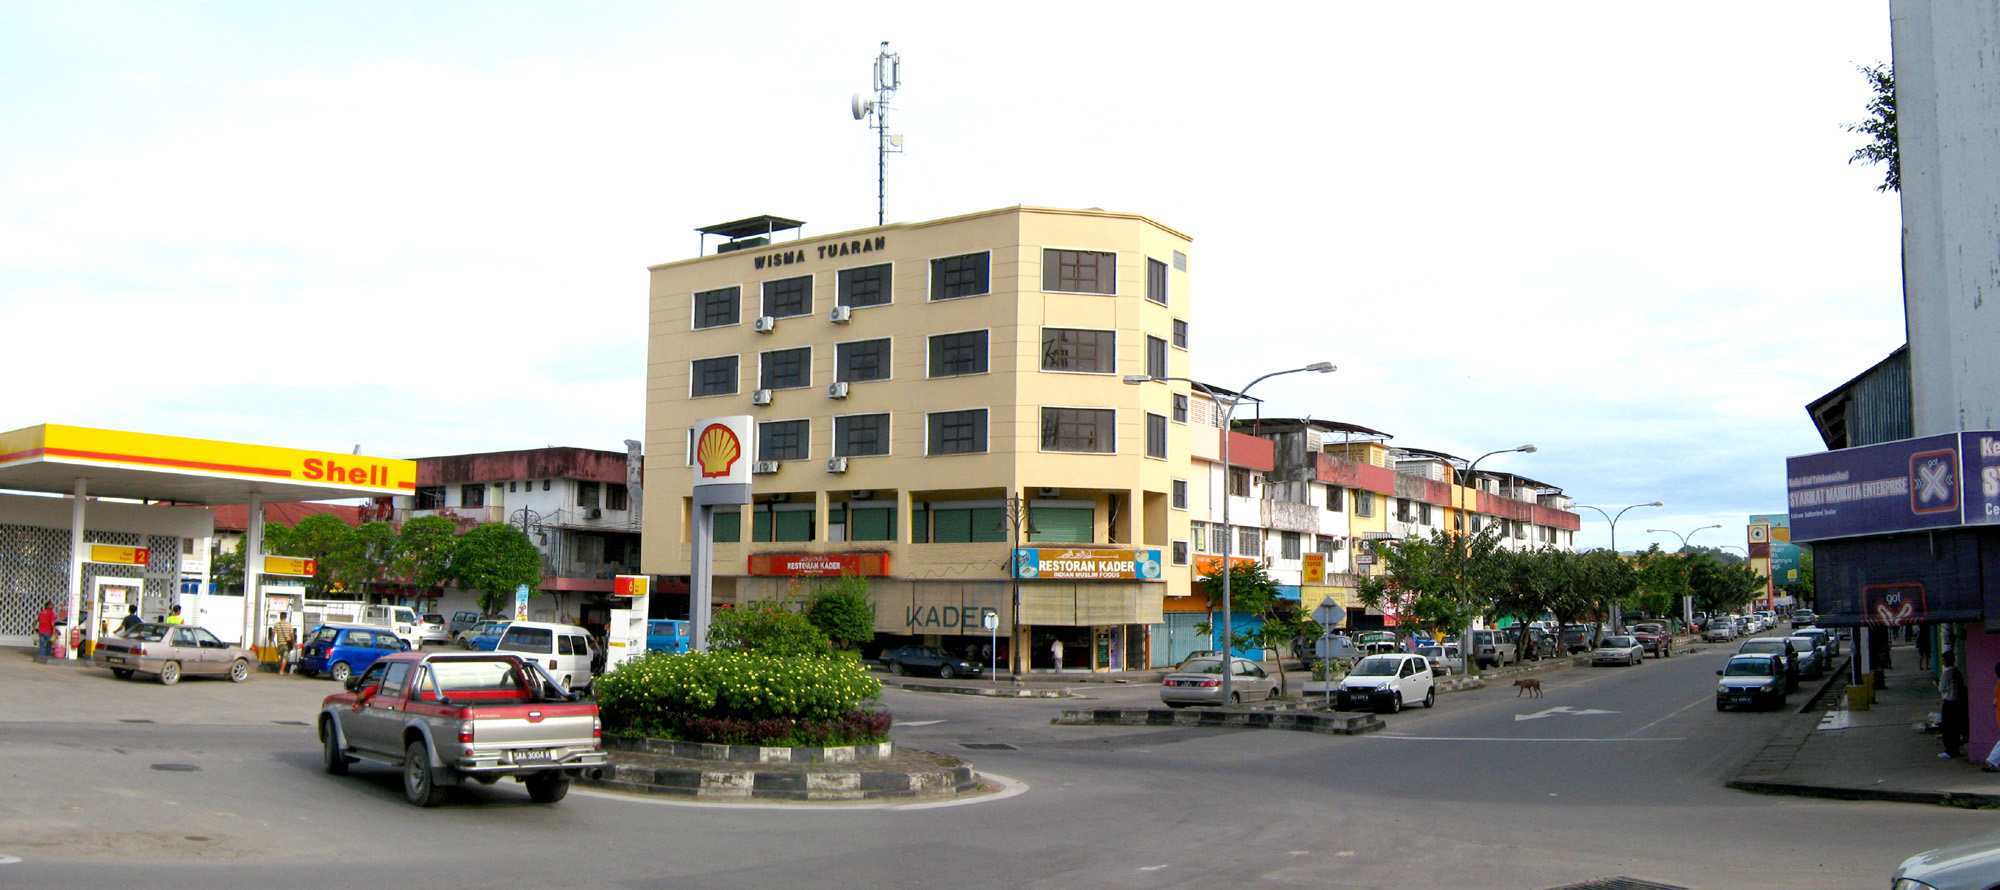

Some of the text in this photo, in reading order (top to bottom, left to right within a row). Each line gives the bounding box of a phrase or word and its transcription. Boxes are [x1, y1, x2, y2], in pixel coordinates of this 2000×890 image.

[754, 236, 885, 270] WISMA TUARAN
[302, 458, 388, 487] Shell
[1982, 466, 2000, 496] S
[1790, 489, 1825, 508] SYARIKAT
[1862, 477, 1908, 497] ENTERPRISE
[138, 551, 146, 562] 2
[306, 562, 314, 573] 4
[787, 562, 841, 570] RESTORAN KADER
[1039, 560, 1135, 572] RESTORAN KADER
[629, 580, 634, 592] 6
[513, 750, 551, 760] SAA 3004 K
